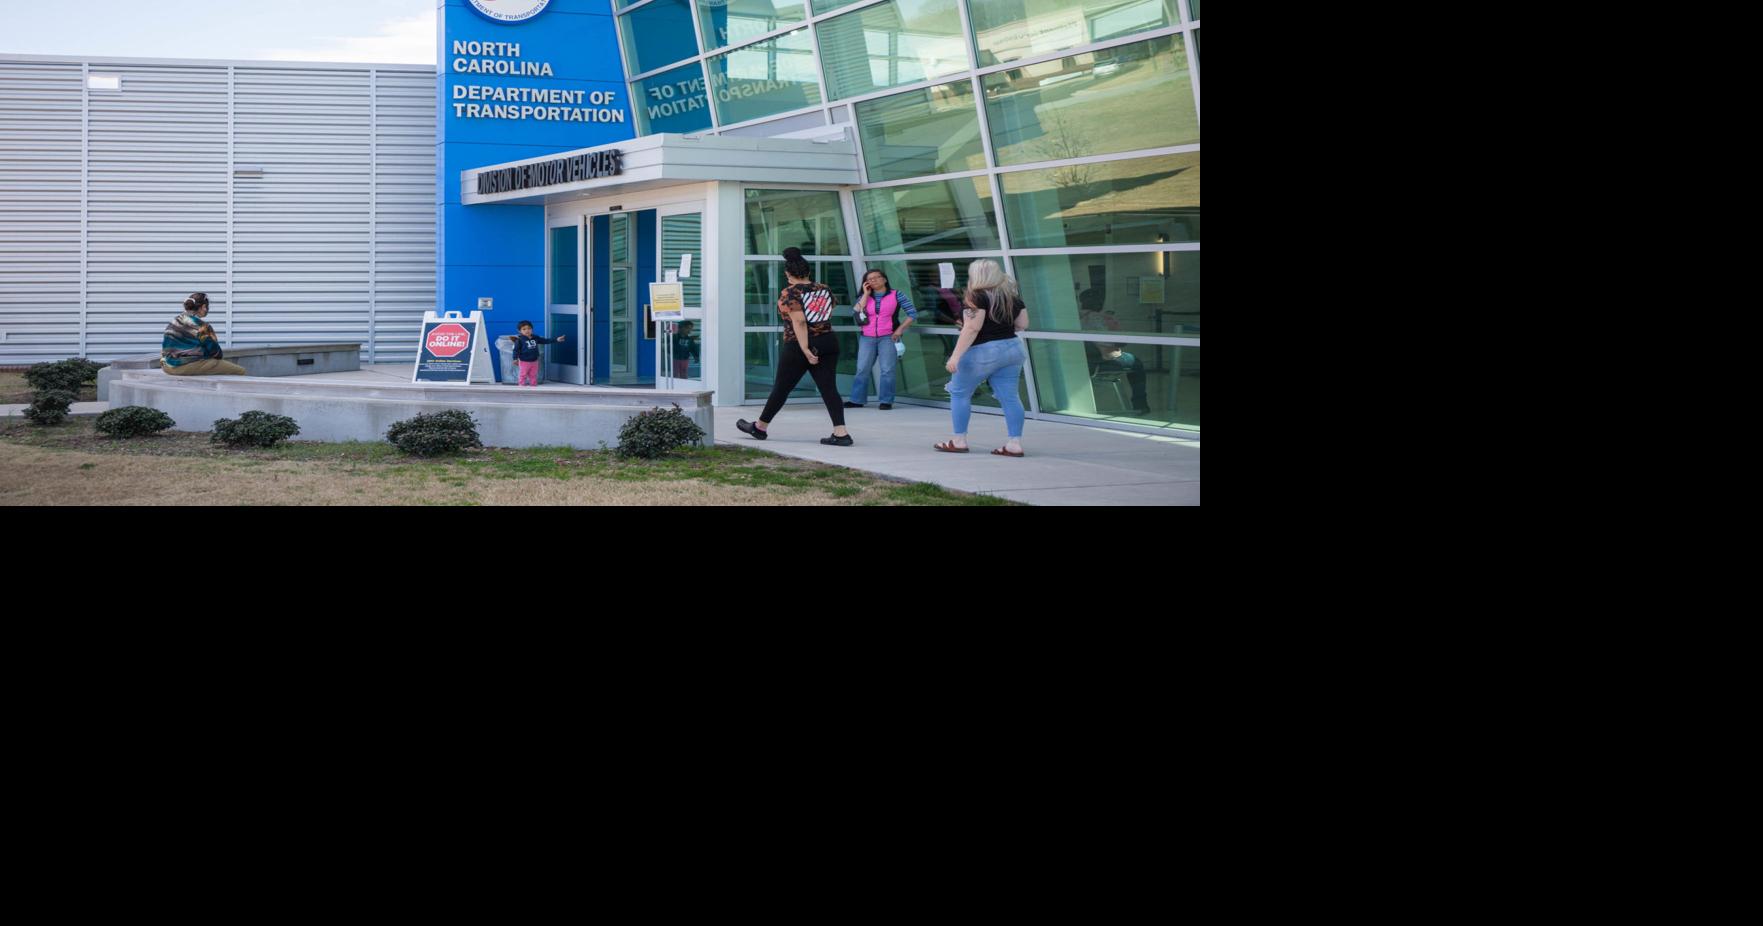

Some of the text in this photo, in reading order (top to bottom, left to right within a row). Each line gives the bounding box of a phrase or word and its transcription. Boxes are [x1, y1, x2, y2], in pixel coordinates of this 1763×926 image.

[453, 40, 520, 57] NORTH
[453, 58, 554, 76] CAROLINA
[453, 85, 616, 105] DEPARTMENT OF
[453, 103, 625, 123] TRANSPORTATION
[478, 150, 617, 194] DIVISION OF MOTOR VEHICLES
